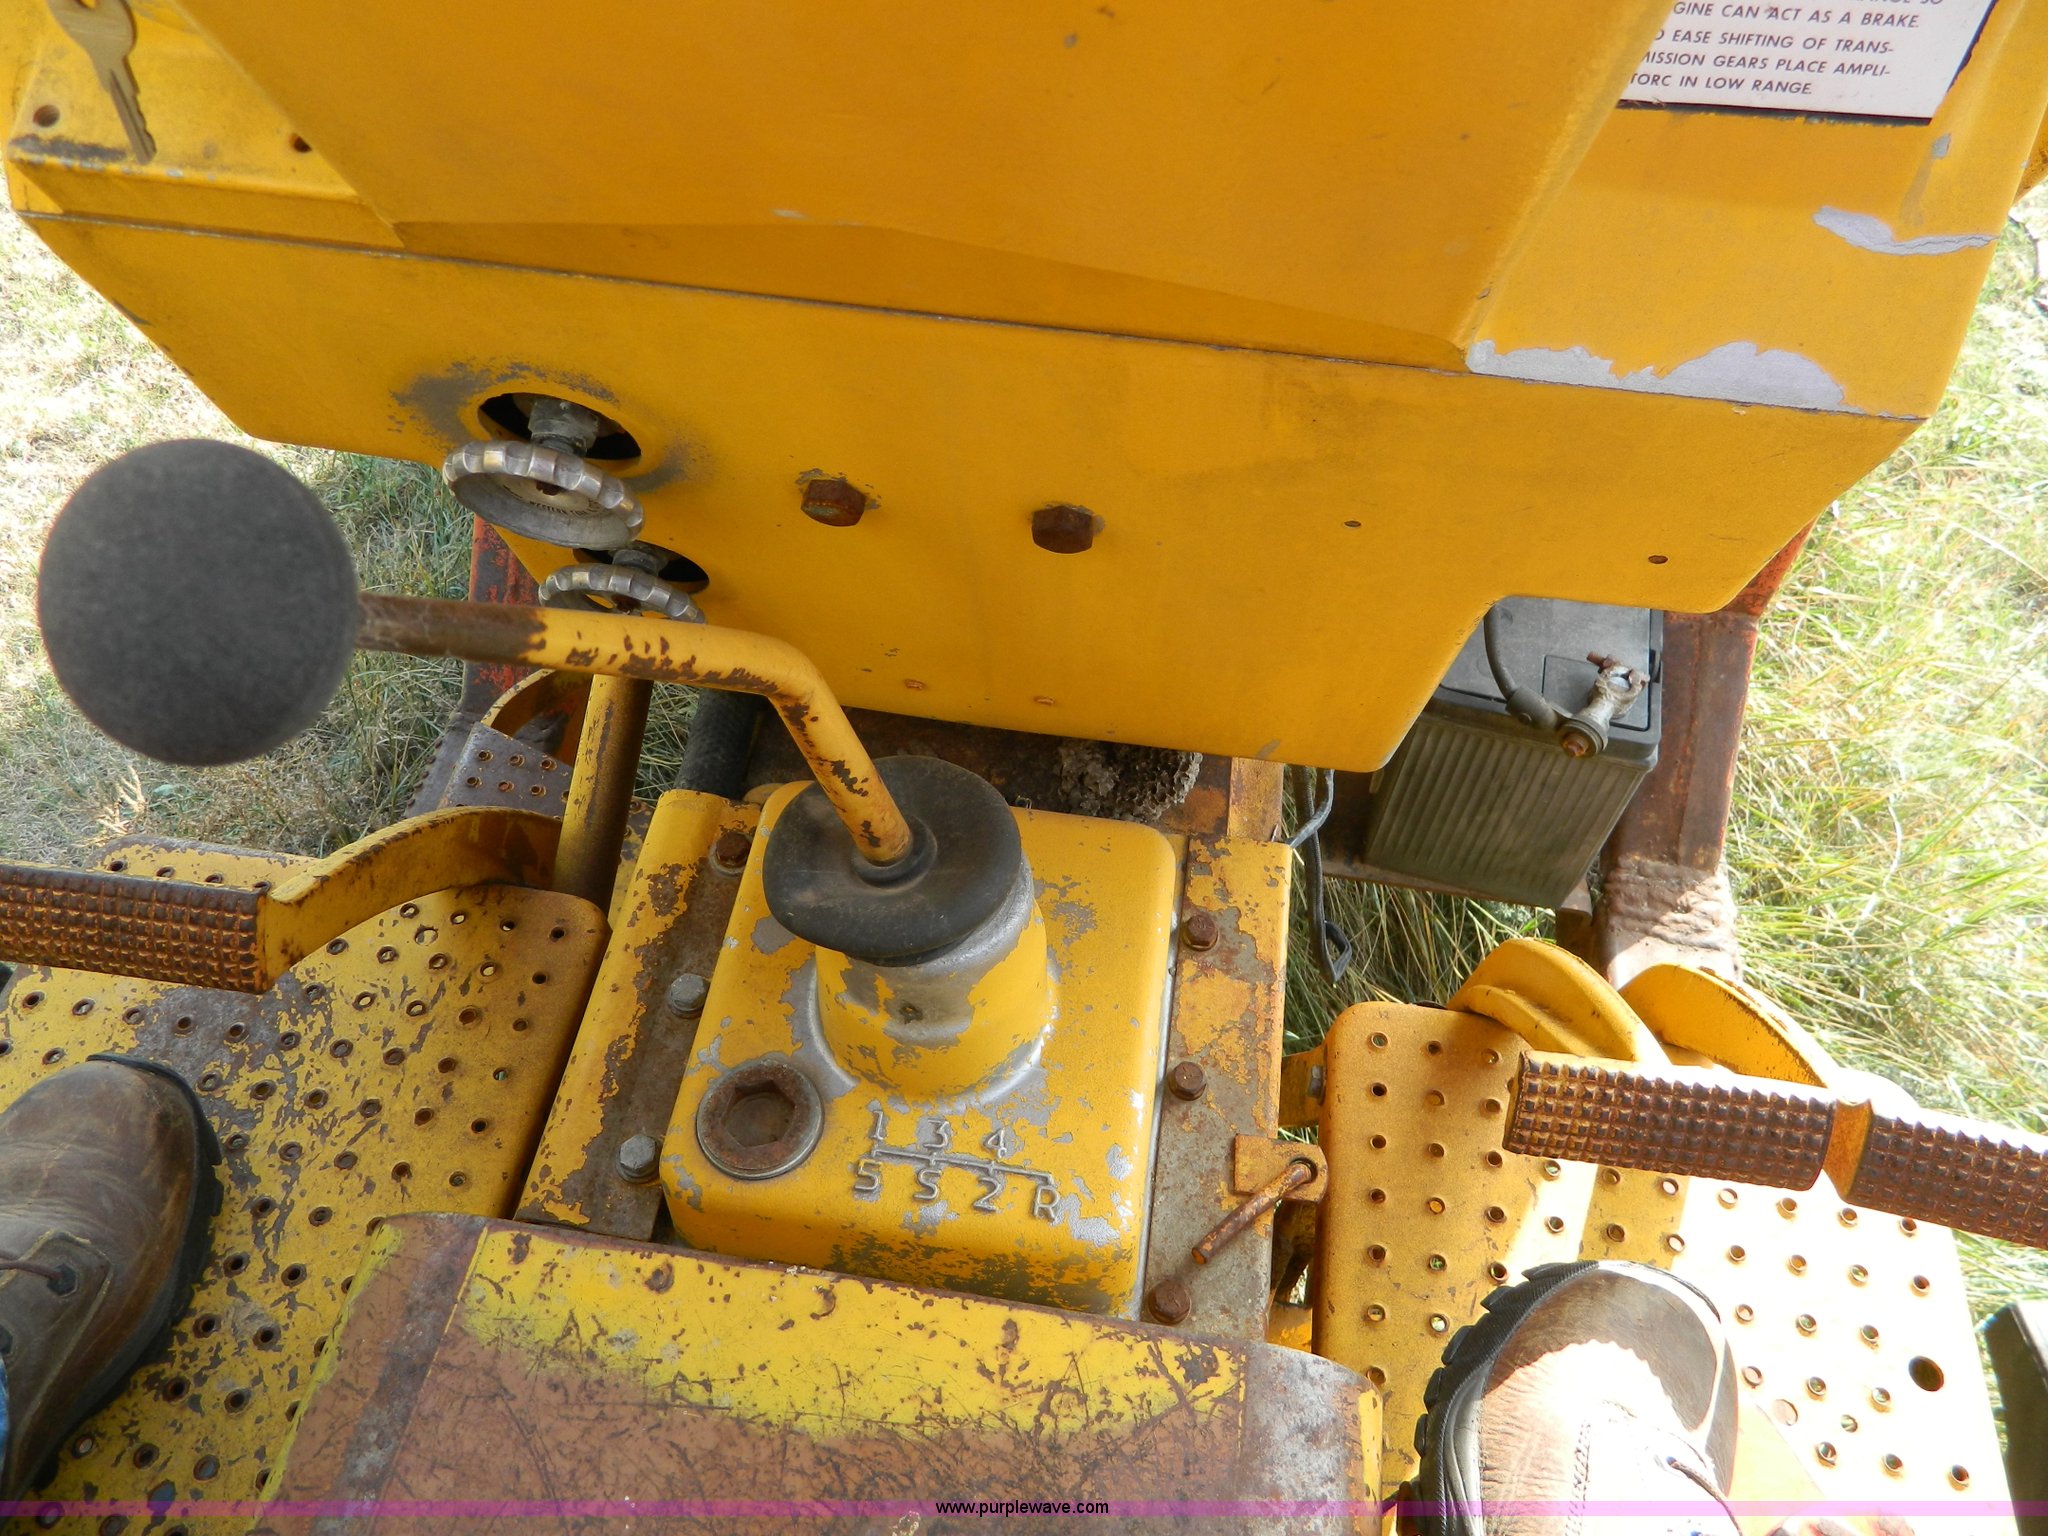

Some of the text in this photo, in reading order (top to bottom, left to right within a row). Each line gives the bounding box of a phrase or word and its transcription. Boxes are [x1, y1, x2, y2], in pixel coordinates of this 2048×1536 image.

[1673, 2, 1713, 17] GINE
[1721, 5, 1760, 19] CAN
[1766, 7, 1801, 21] ACT
[1808, 10, 1832, 24] AS
[1838, 12, 1851, 25] A
[1671, 29, 1712, 44] EASE
[1718, 32, 1794, 49] SHIFTING
[1802, 37, 1827, 50] OF
[1835, 39, 1894, 54] TRANS-
[1713, 55, 1769, 70] GEARS
[1775, 58, 1827, 74] PLACE
[1833, 62, 1891, 77] AMPLI-
[1679, 75, 1698, 88] IN
[1705, 77, 1745, 90] LOW
[923, 1118, 950, 1149] 3
[985, 1127, 1008, 1160] 4
[973, 1176, 1001, 1212] 2
[1033, 1184, 1060, 1223] R
